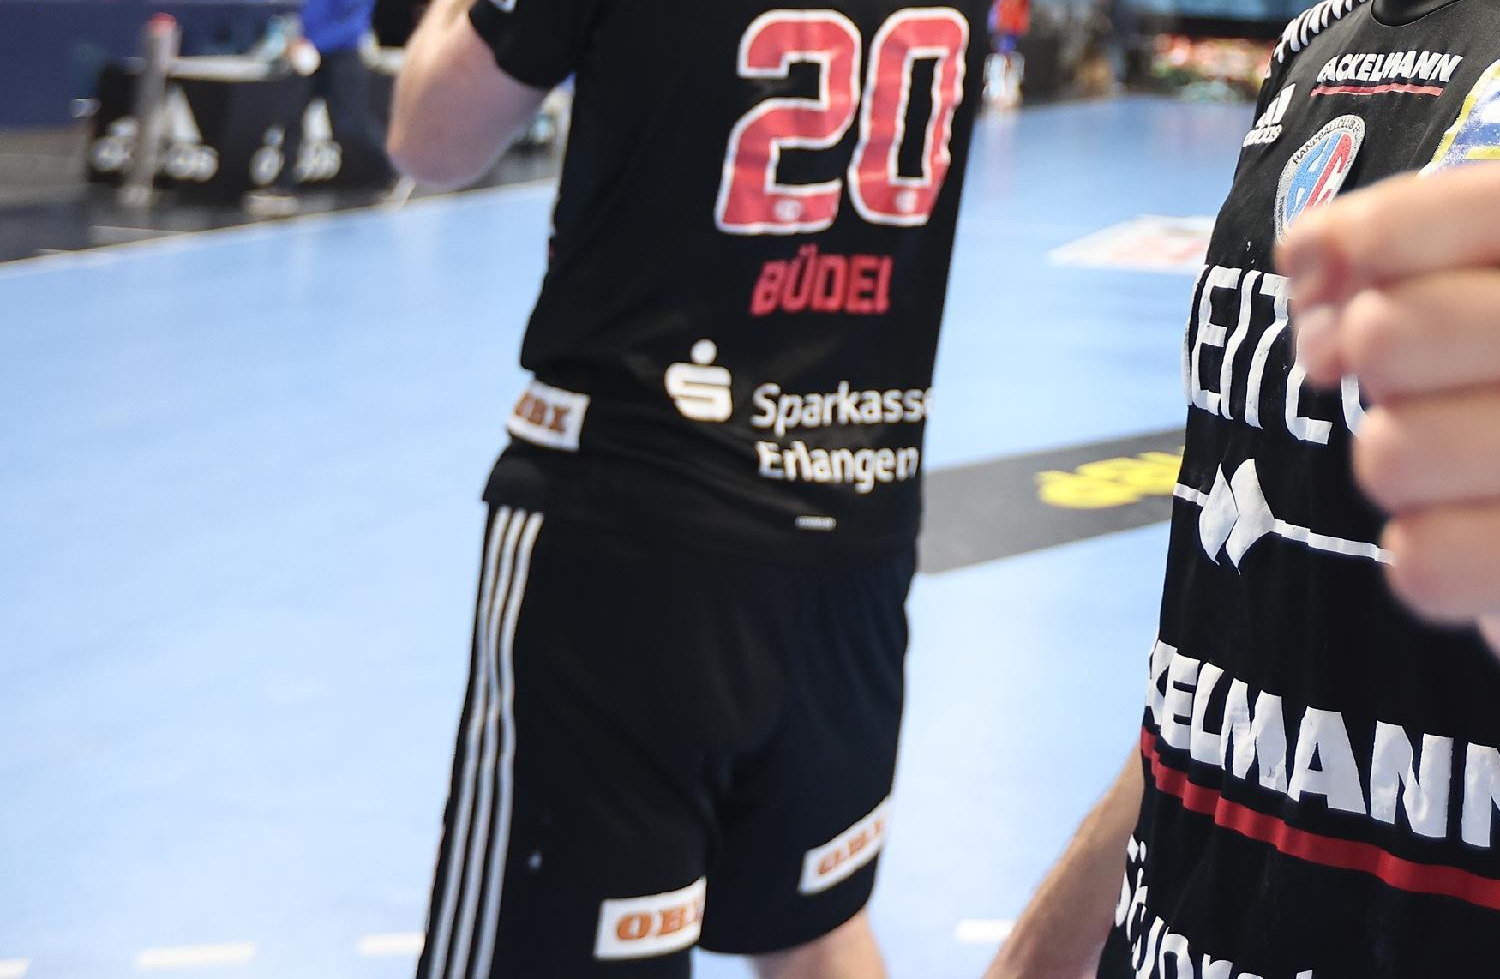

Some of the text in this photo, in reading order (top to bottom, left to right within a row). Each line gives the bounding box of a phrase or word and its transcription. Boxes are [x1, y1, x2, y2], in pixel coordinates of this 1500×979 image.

[1315, 50, 1464, 83] ACKELMANN
[714, 6, 970, 235] 20
[755, 440, 920, 495] Erlangen
